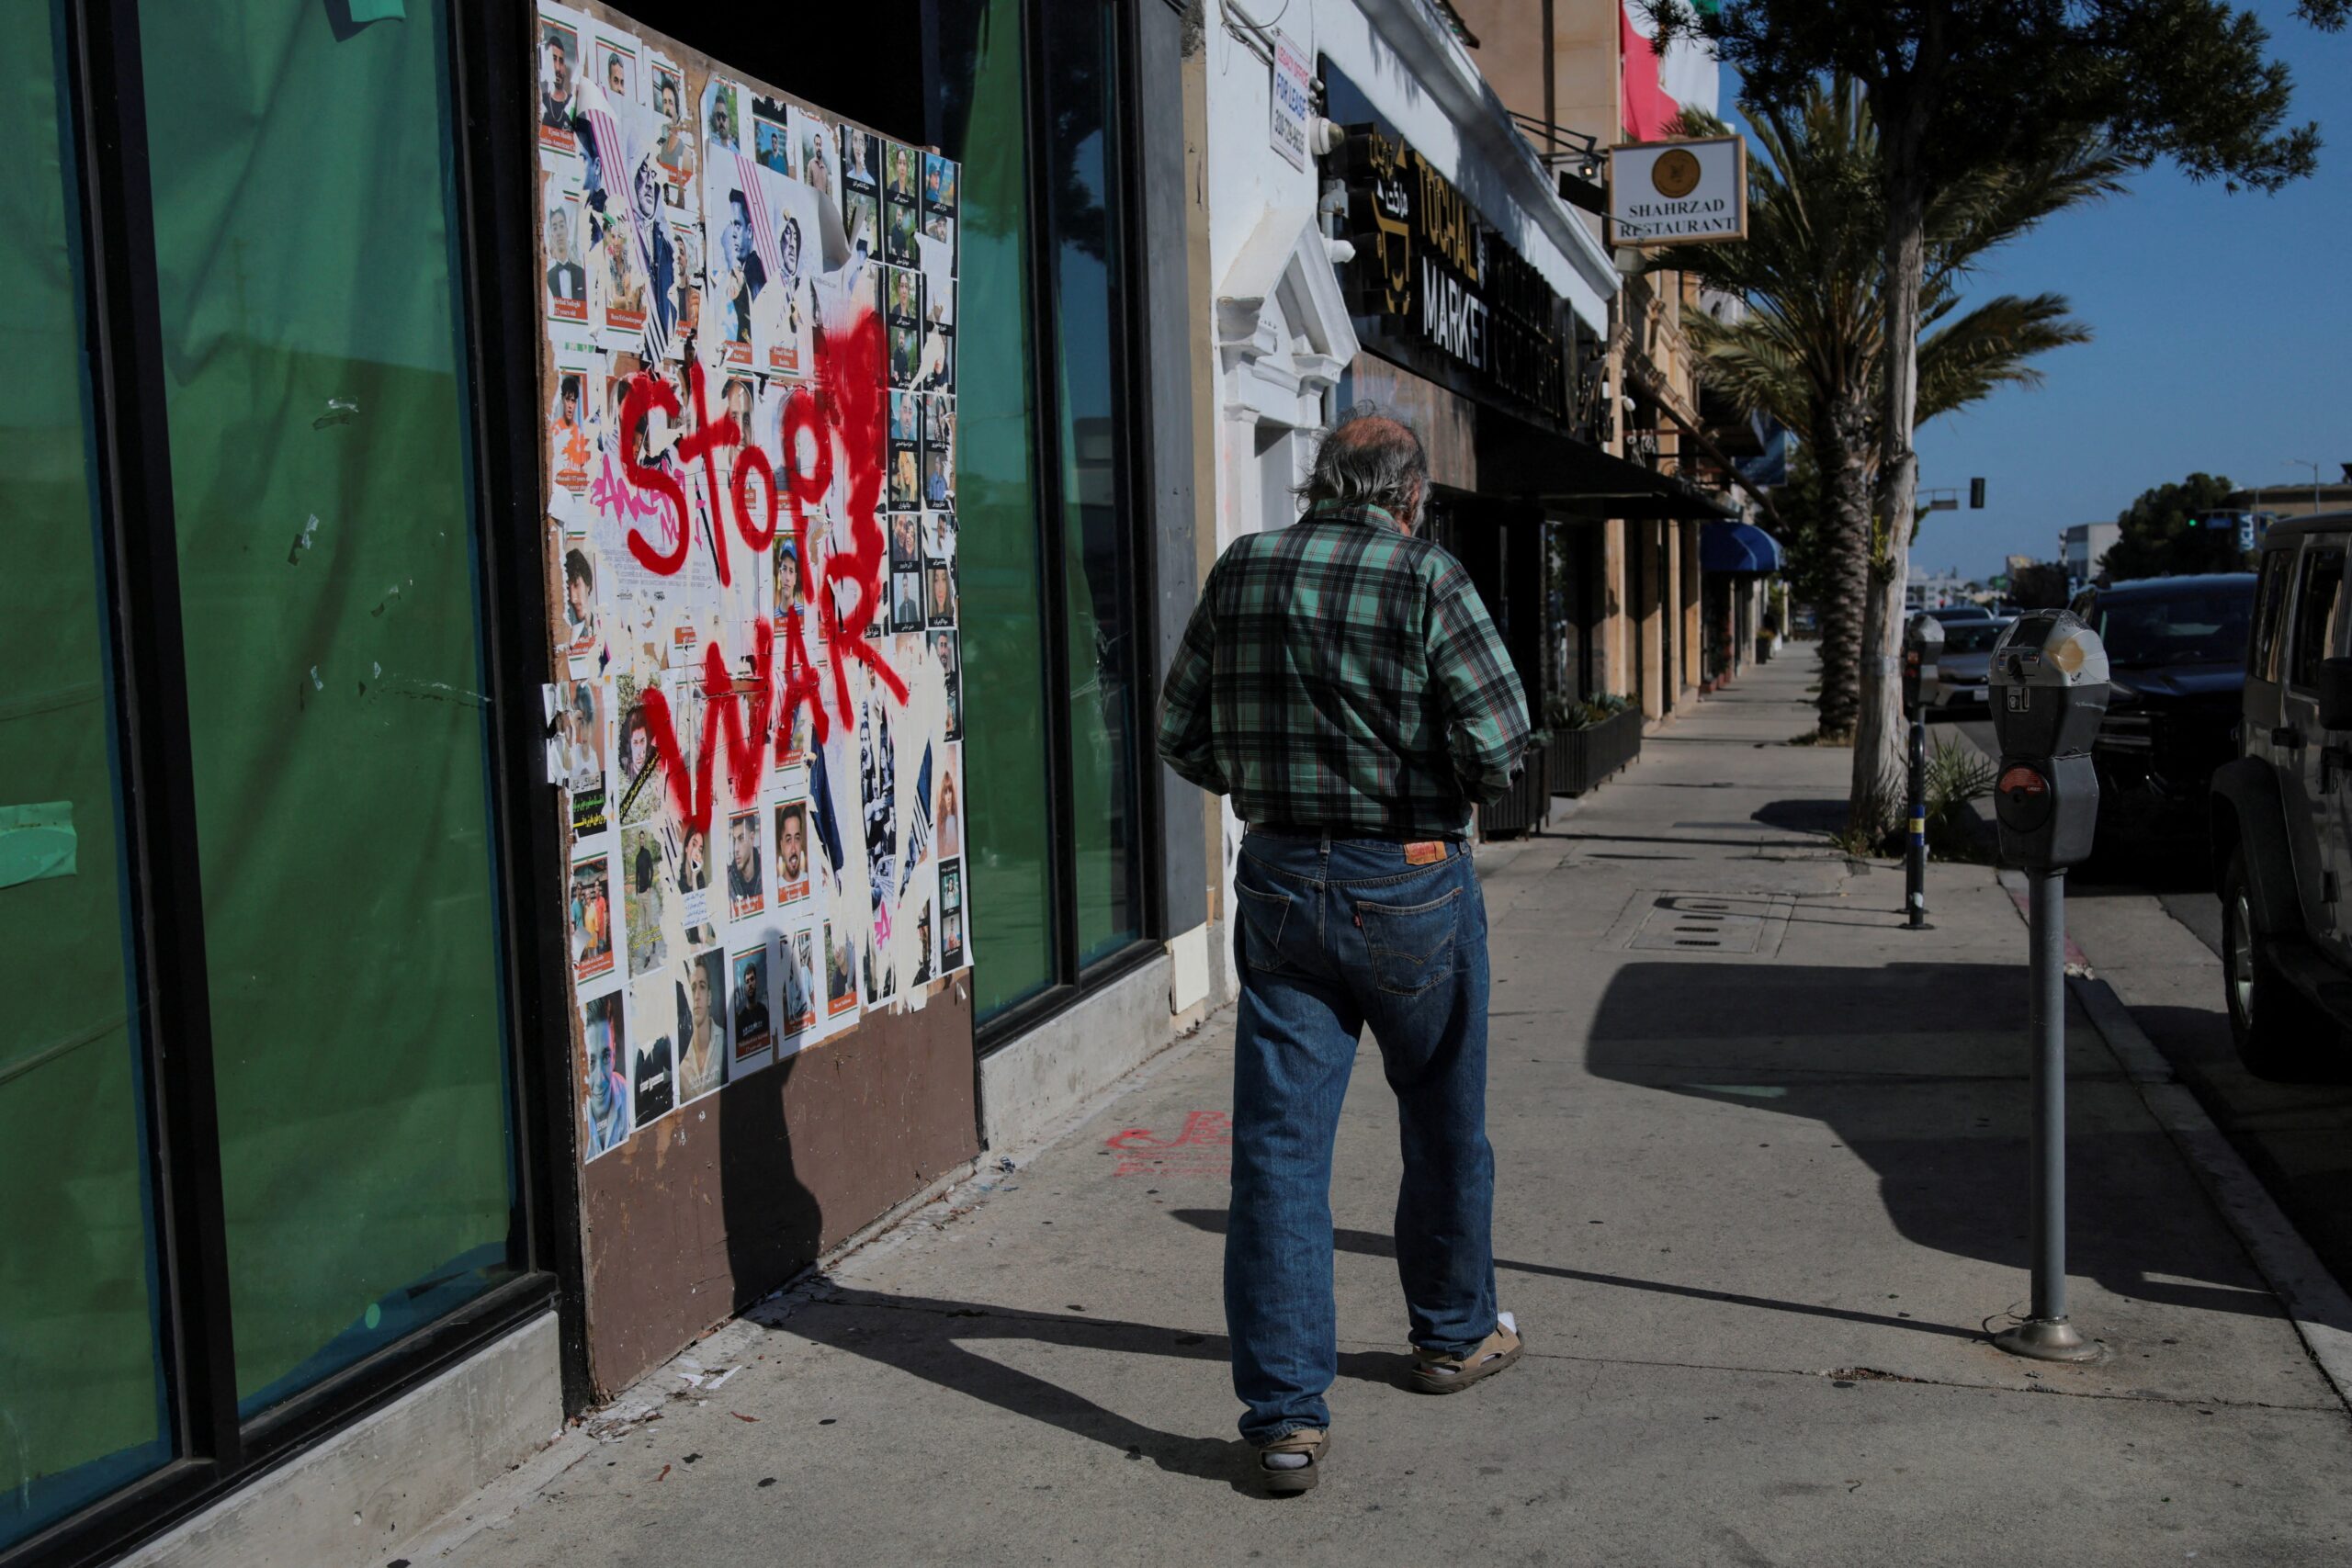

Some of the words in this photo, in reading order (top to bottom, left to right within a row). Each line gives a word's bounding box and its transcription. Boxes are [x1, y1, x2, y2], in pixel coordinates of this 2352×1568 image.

[1294, 62, 1309, 88] OFFICE
[1276, 73, 1288, 104] FOR
[1288, 85, 1307, 120] LEASE
[1414, 151, 1477, 284] TOCHAL
[1621, 217, 1736, 237] RESTAURANT
[1628, 199, 1724, 218] SHAHRZAD
[1422, 255, 1489, 374] MARKET
[2240, 514, 2255, 552] UCLA
[641, 553, 908, 833] WAR
